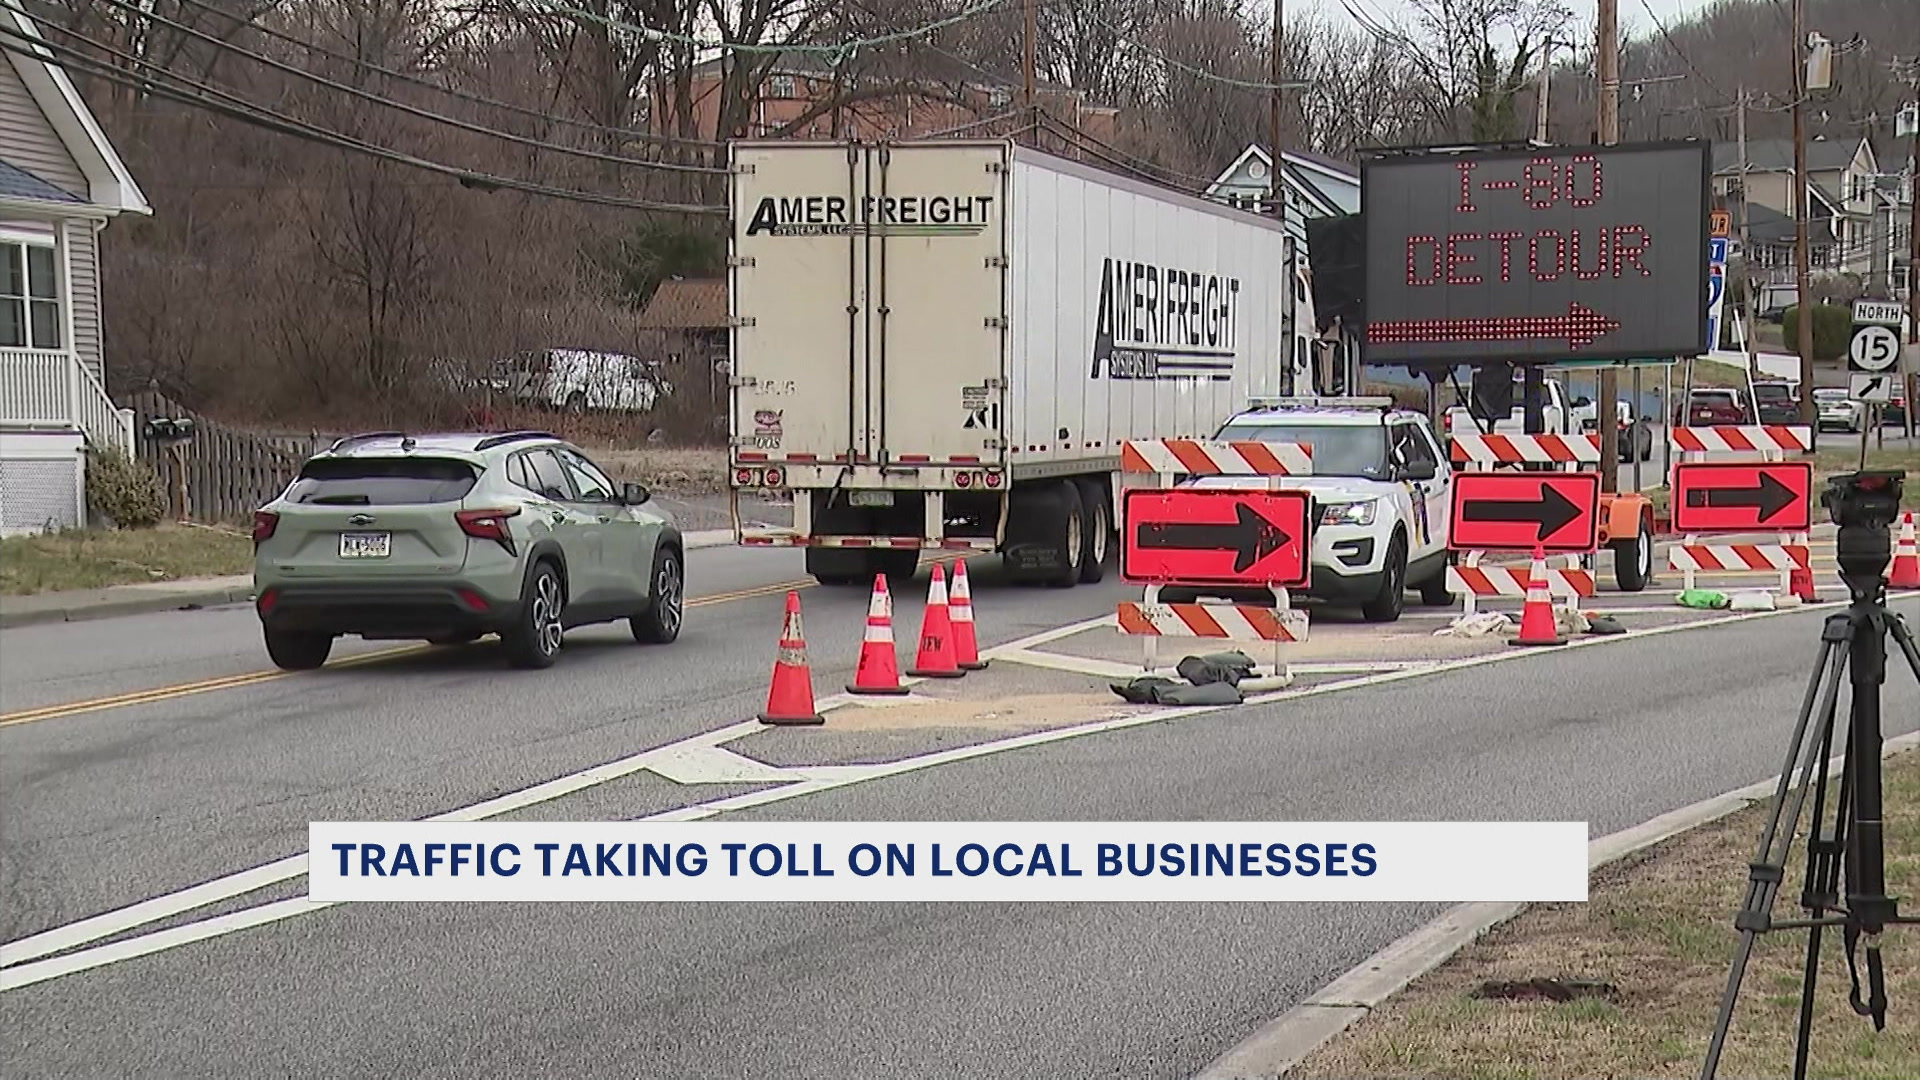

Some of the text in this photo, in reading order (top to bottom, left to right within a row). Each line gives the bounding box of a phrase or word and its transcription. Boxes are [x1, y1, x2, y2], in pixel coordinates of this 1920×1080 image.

[1455, 155, 1602, 212] I-80
[746, 196, 994, 236] AMERFREIGHT
[1407, 224, 1651, 285] DETOUR
[1090, 257, 1240, 380] AMERIFREIGHT
[1858, 304, 1899, 319] NORTH
[1861, 334, 1889, 361] 15
